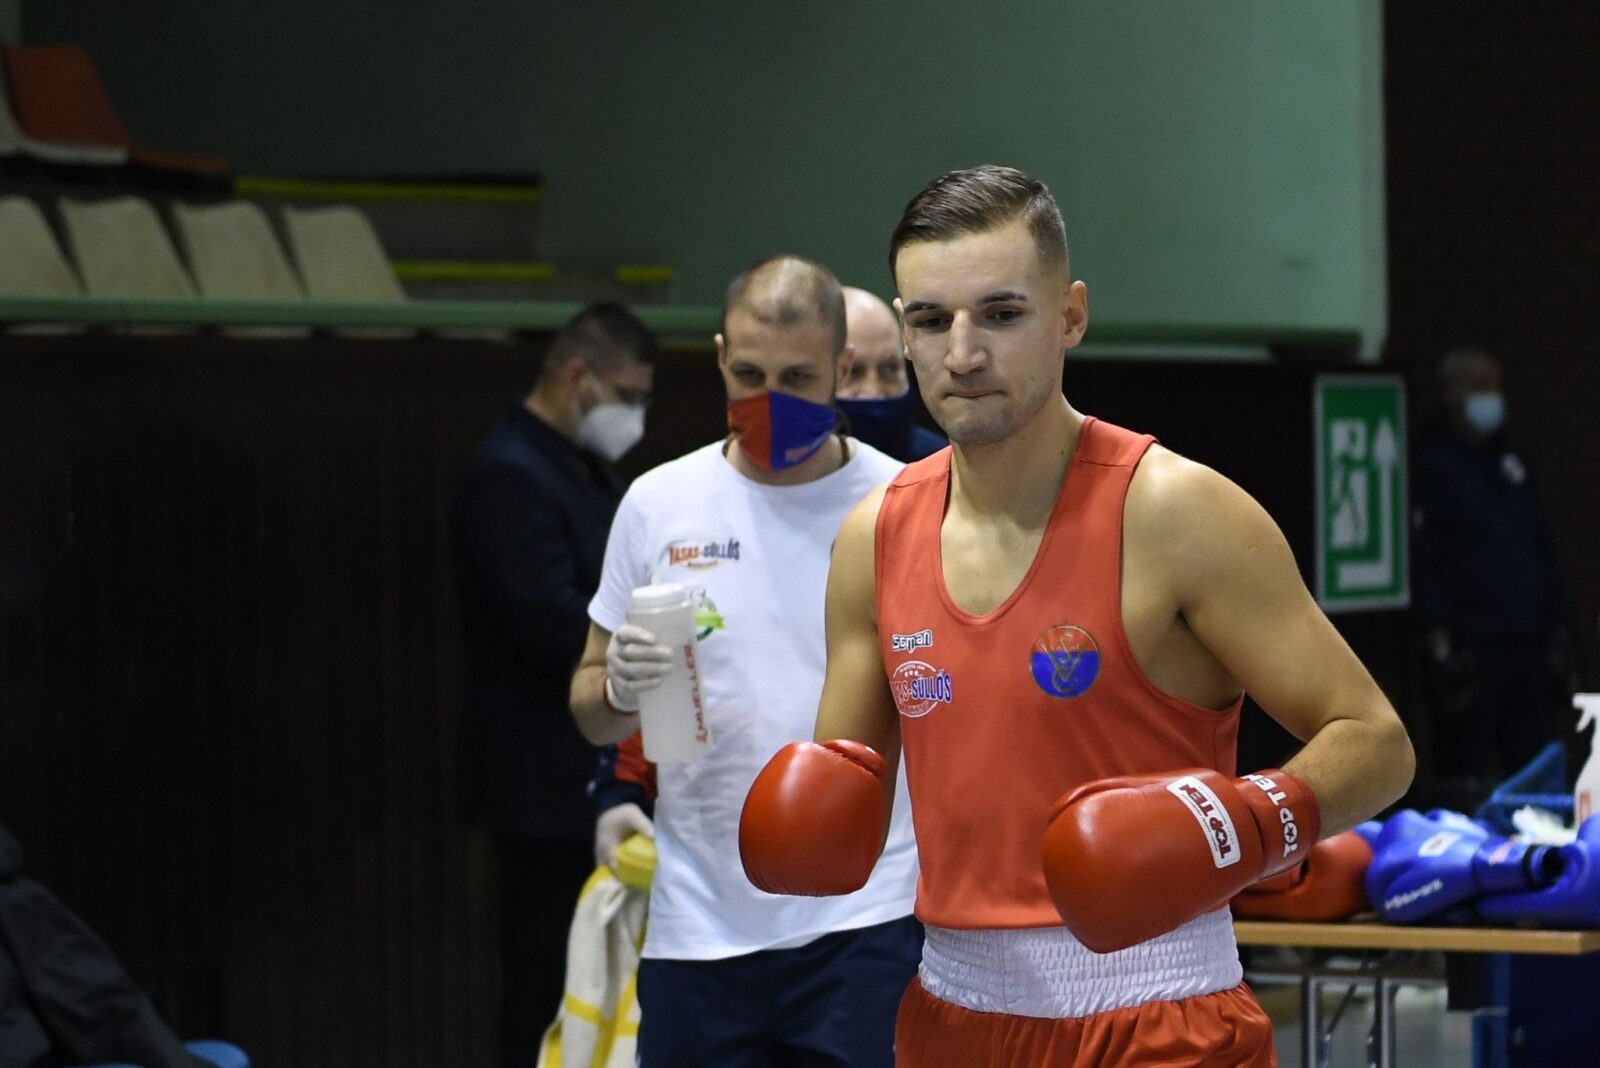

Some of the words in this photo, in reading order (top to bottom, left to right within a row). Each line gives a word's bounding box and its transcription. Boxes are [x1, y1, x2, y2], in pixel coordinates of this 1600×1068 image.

[1179, 783, 1214, 817] TEN
[1209, 816, 1232, 859] TOP
[1279, 807, 1298, 858] TOP
